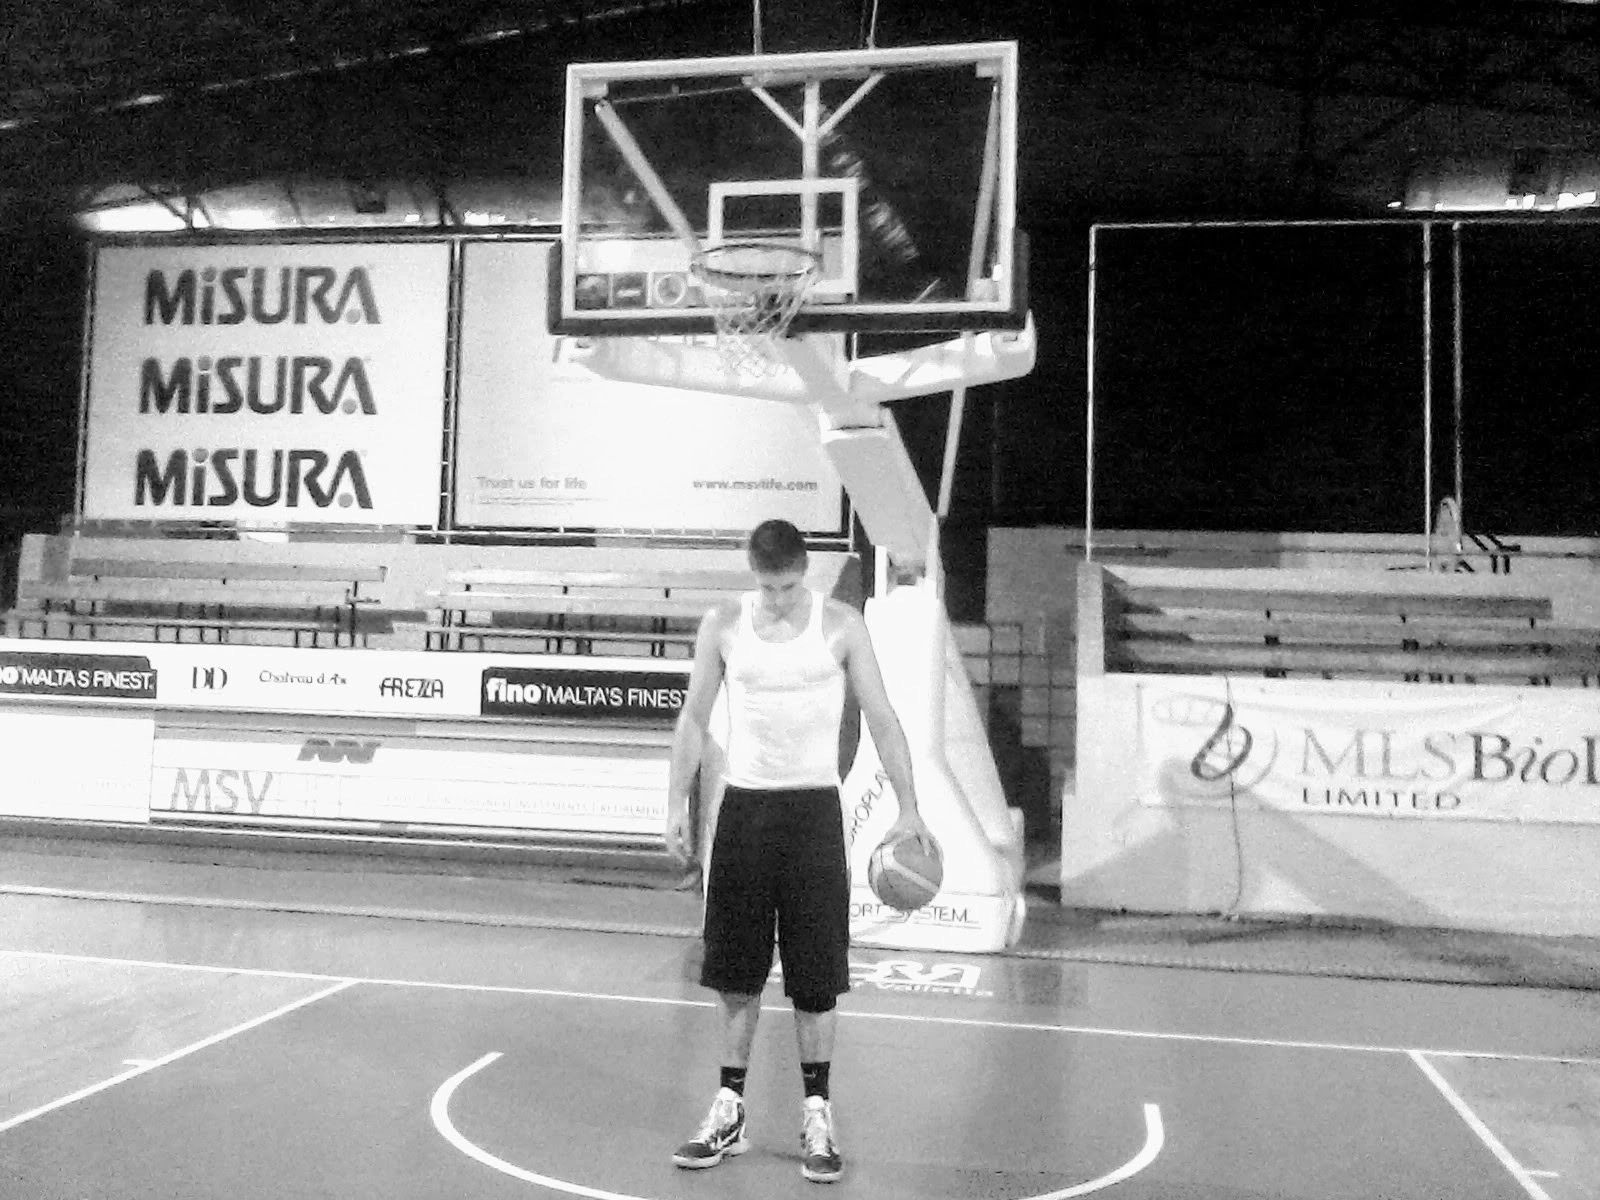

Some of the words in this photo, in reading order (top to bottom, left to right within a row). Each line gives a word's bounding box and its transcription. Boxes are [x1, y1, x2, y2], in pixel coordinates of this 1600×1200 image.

[518, 479, 536, 490] us
[539, 476, 560, 490] for
[485, 677, 542, 704] fino
[546, 685, 624, 707] MALTA'S
[170, 767, 274, 814] MSV
[1301, 787, 1462, 810] LIMITED
